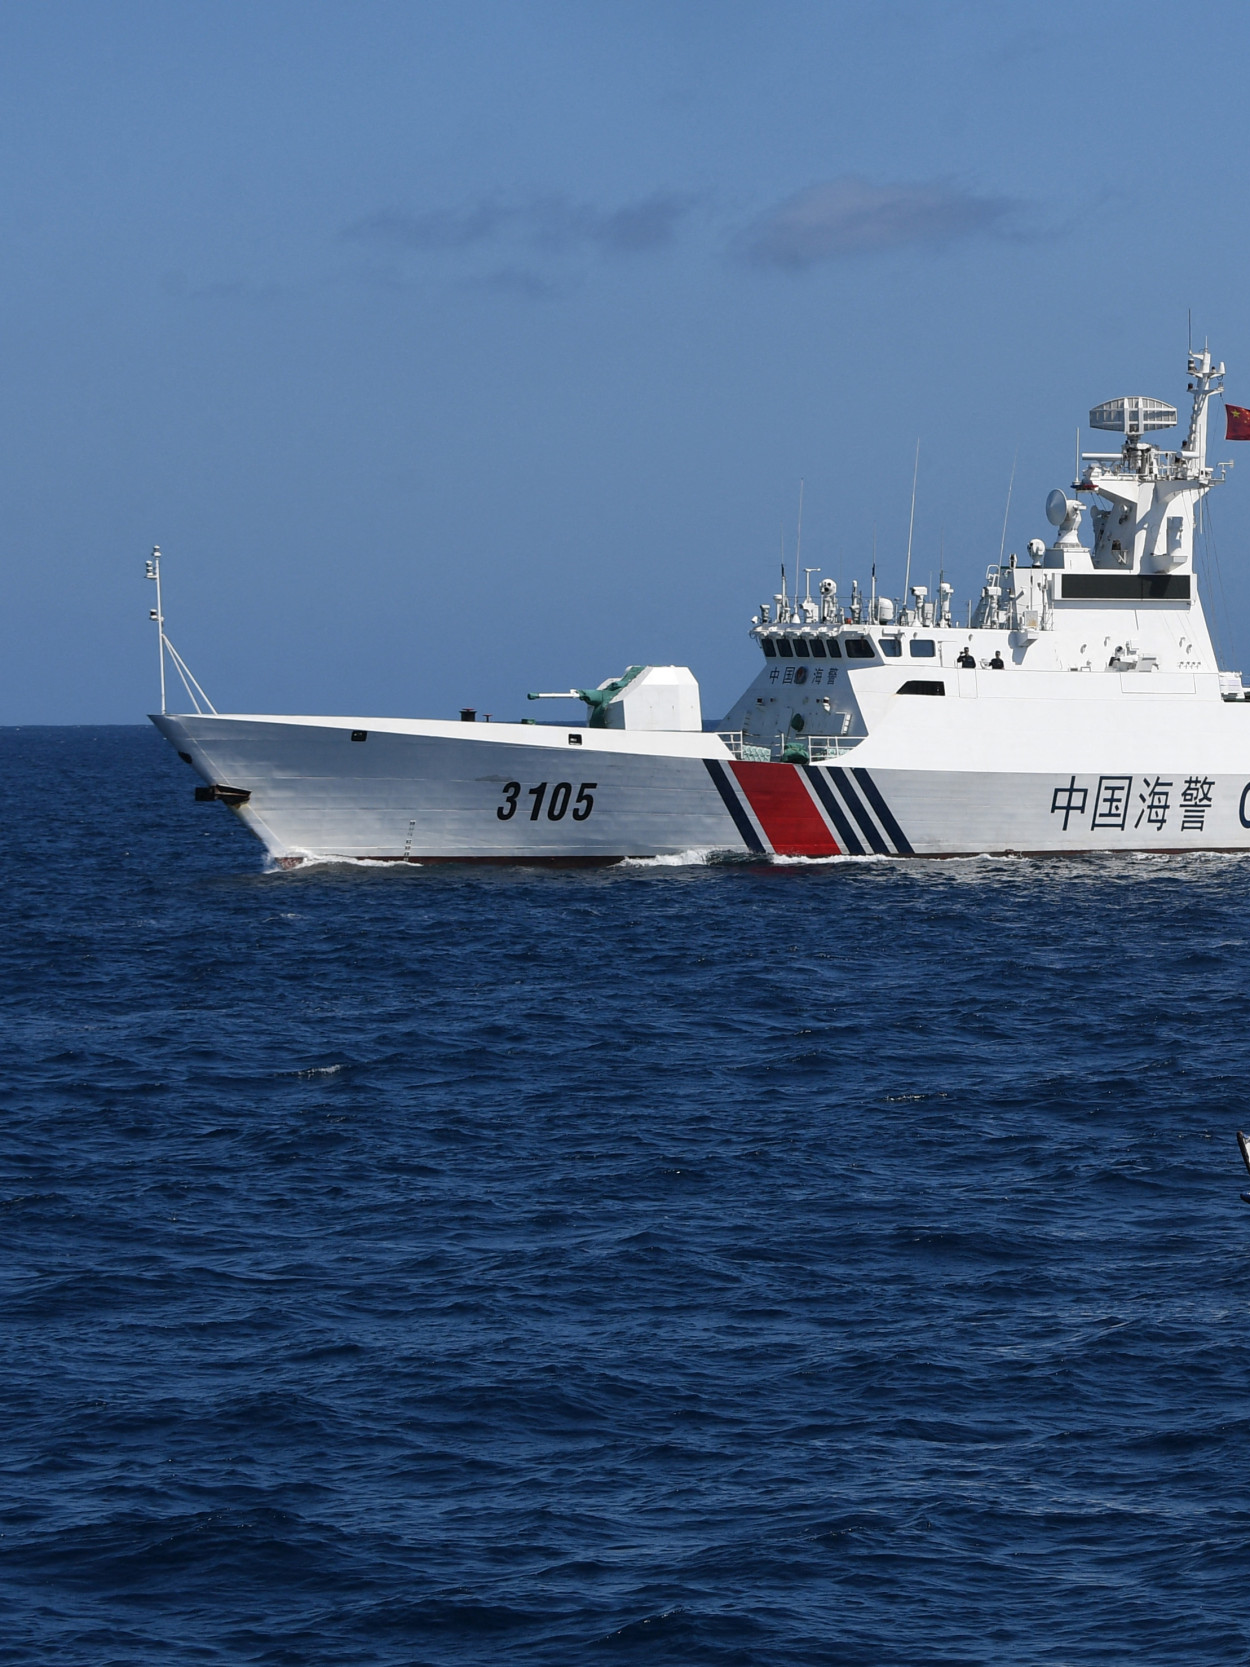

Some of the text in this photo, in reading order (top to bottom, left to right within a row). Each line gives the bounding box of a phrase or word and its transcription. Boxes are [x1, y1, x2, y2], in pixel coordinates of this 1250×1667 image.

[497, 781, 598, 822] 3105
[1050, 775, 1215, 832] 中国海警
